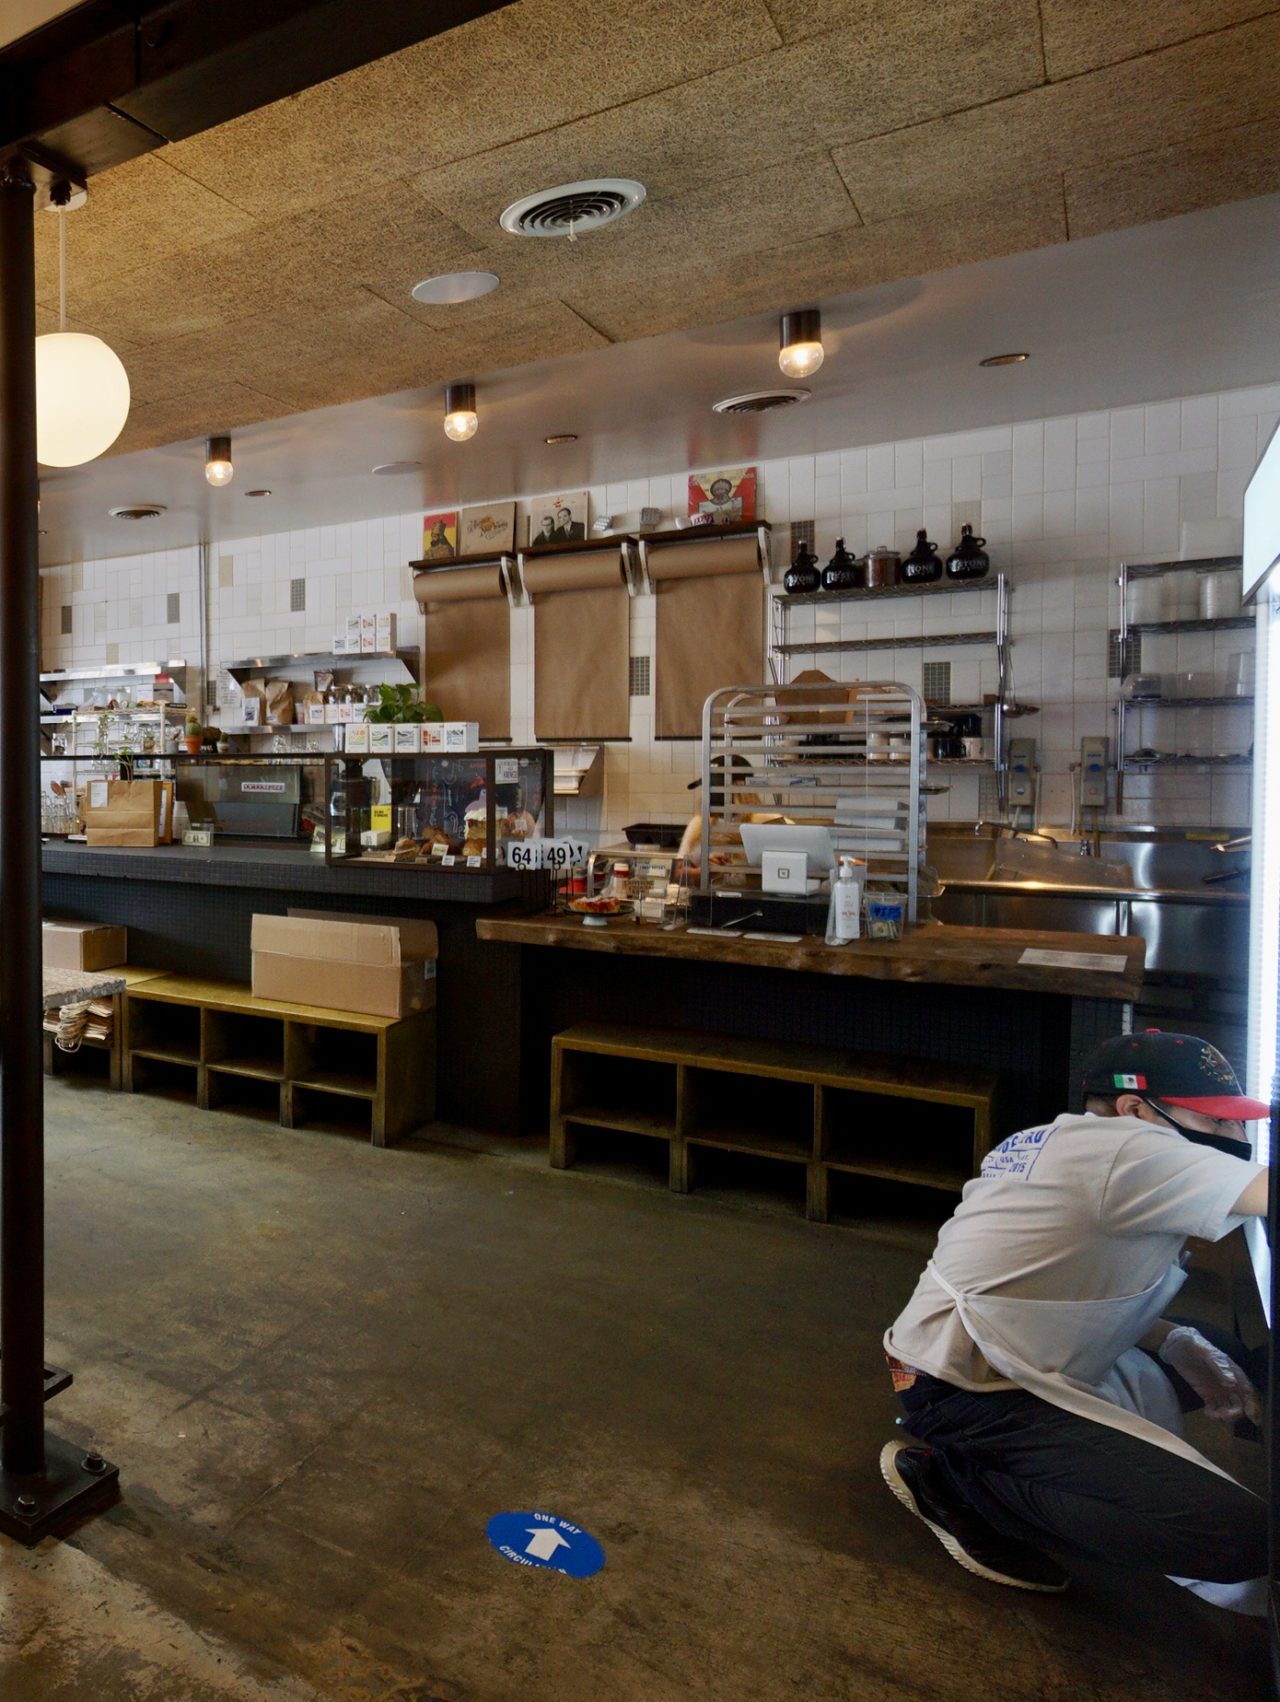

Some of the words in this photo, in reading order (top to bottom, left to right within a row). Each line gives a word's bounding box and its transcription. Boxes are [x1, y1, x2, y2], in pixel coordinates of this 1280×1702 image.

[512, 846, 532, 865] 64
[547, 847, 567, 865] 49
[533, 1512, 556, 1524] ONE
[558, 1520, 582, 1535] WAY
